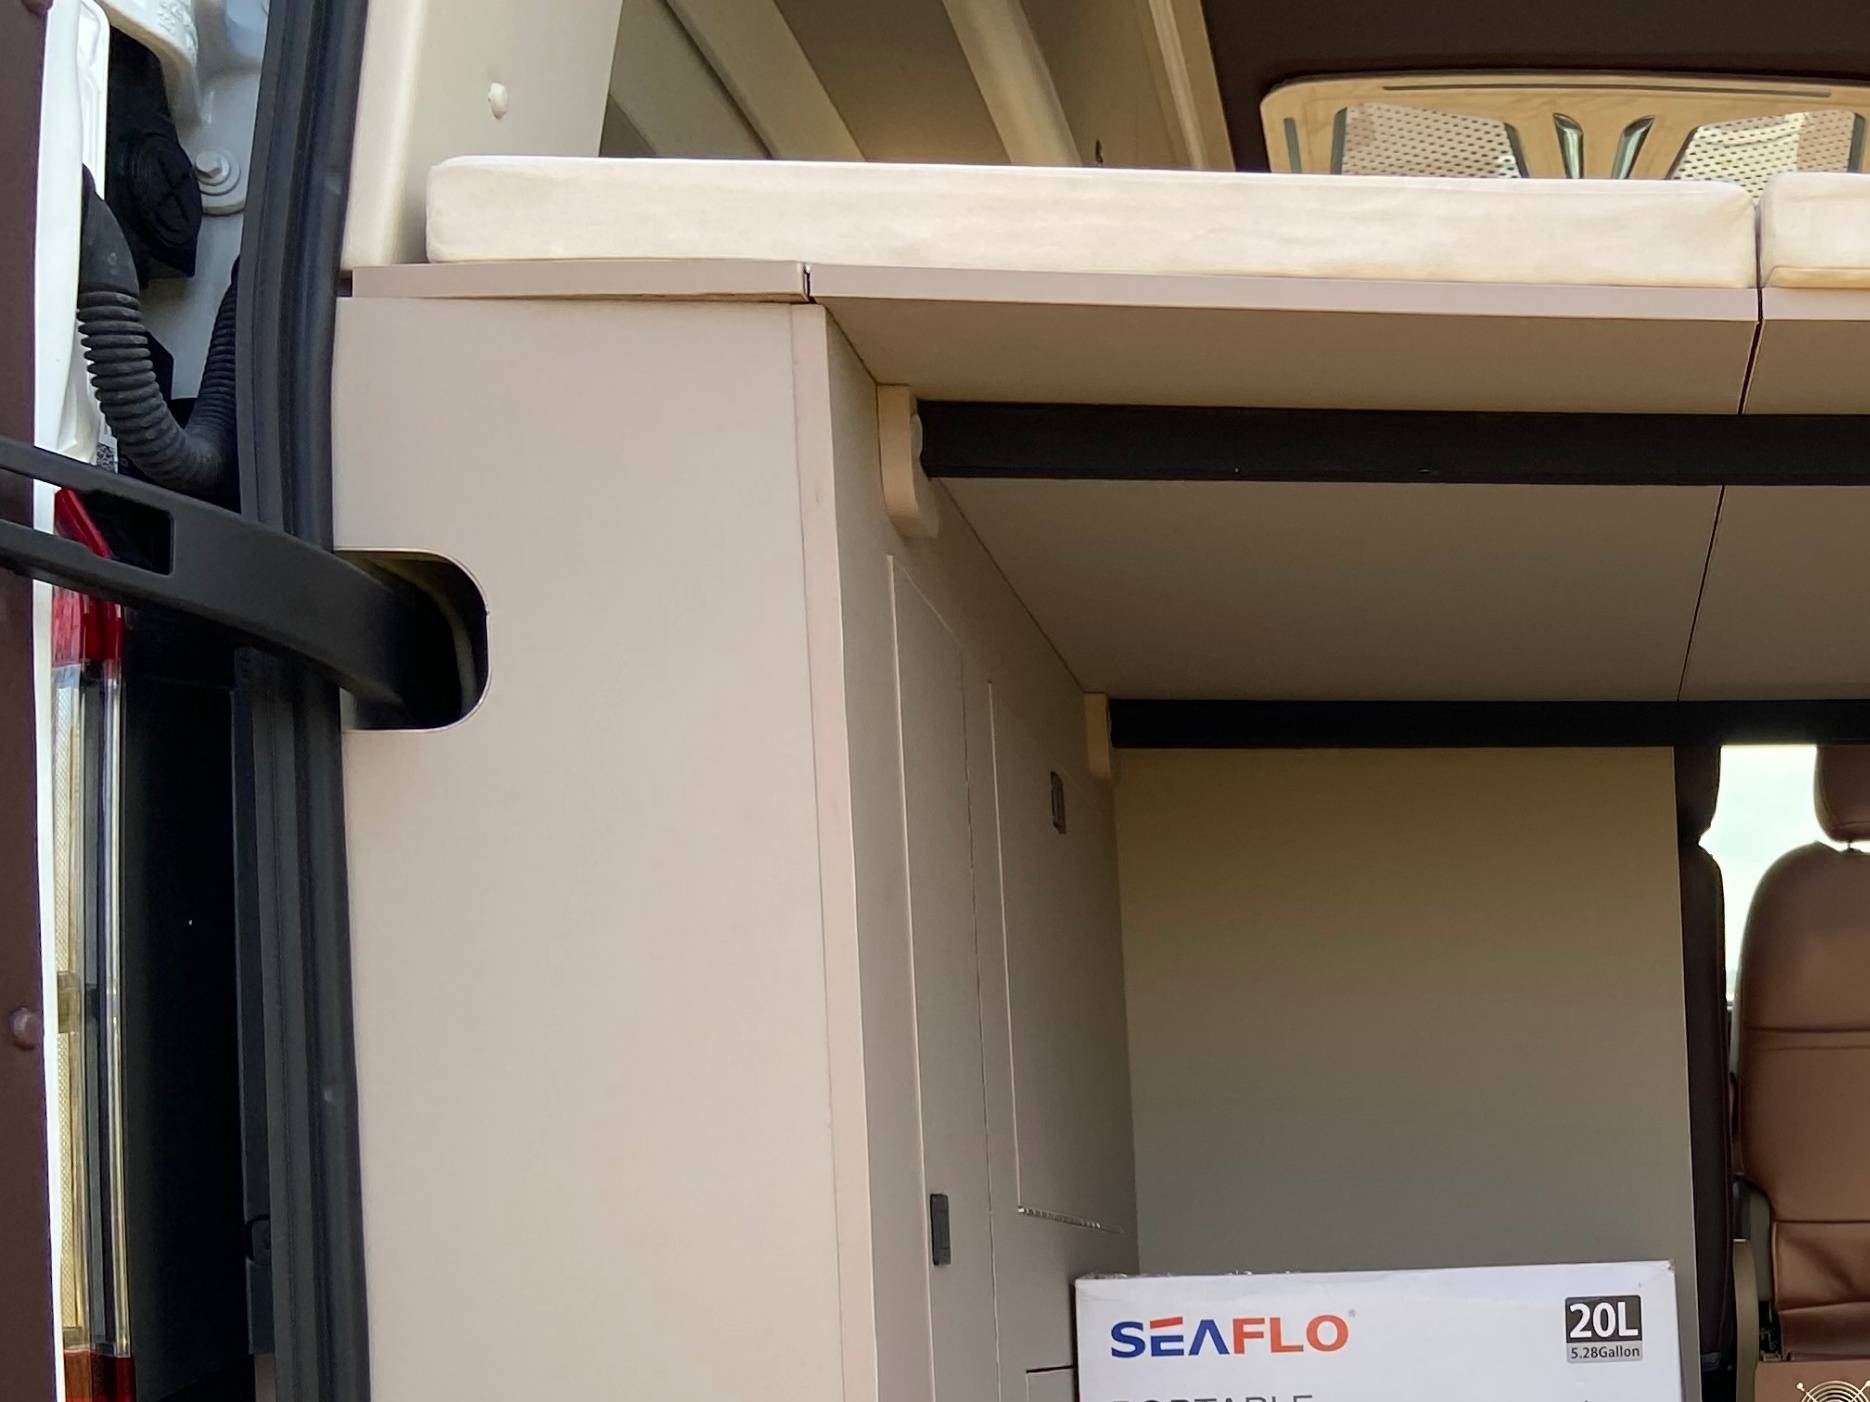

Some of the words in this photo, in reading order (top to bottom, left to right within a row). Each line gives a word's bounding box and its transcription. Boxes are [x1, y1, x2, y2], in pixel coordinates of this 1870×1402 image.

[1110, 1314, 1349, 1358] SEAFLO
[1569, 1301, 1639, 1338] 20L
[1570, 1345, 1641, 1360] 5.28Gallon
